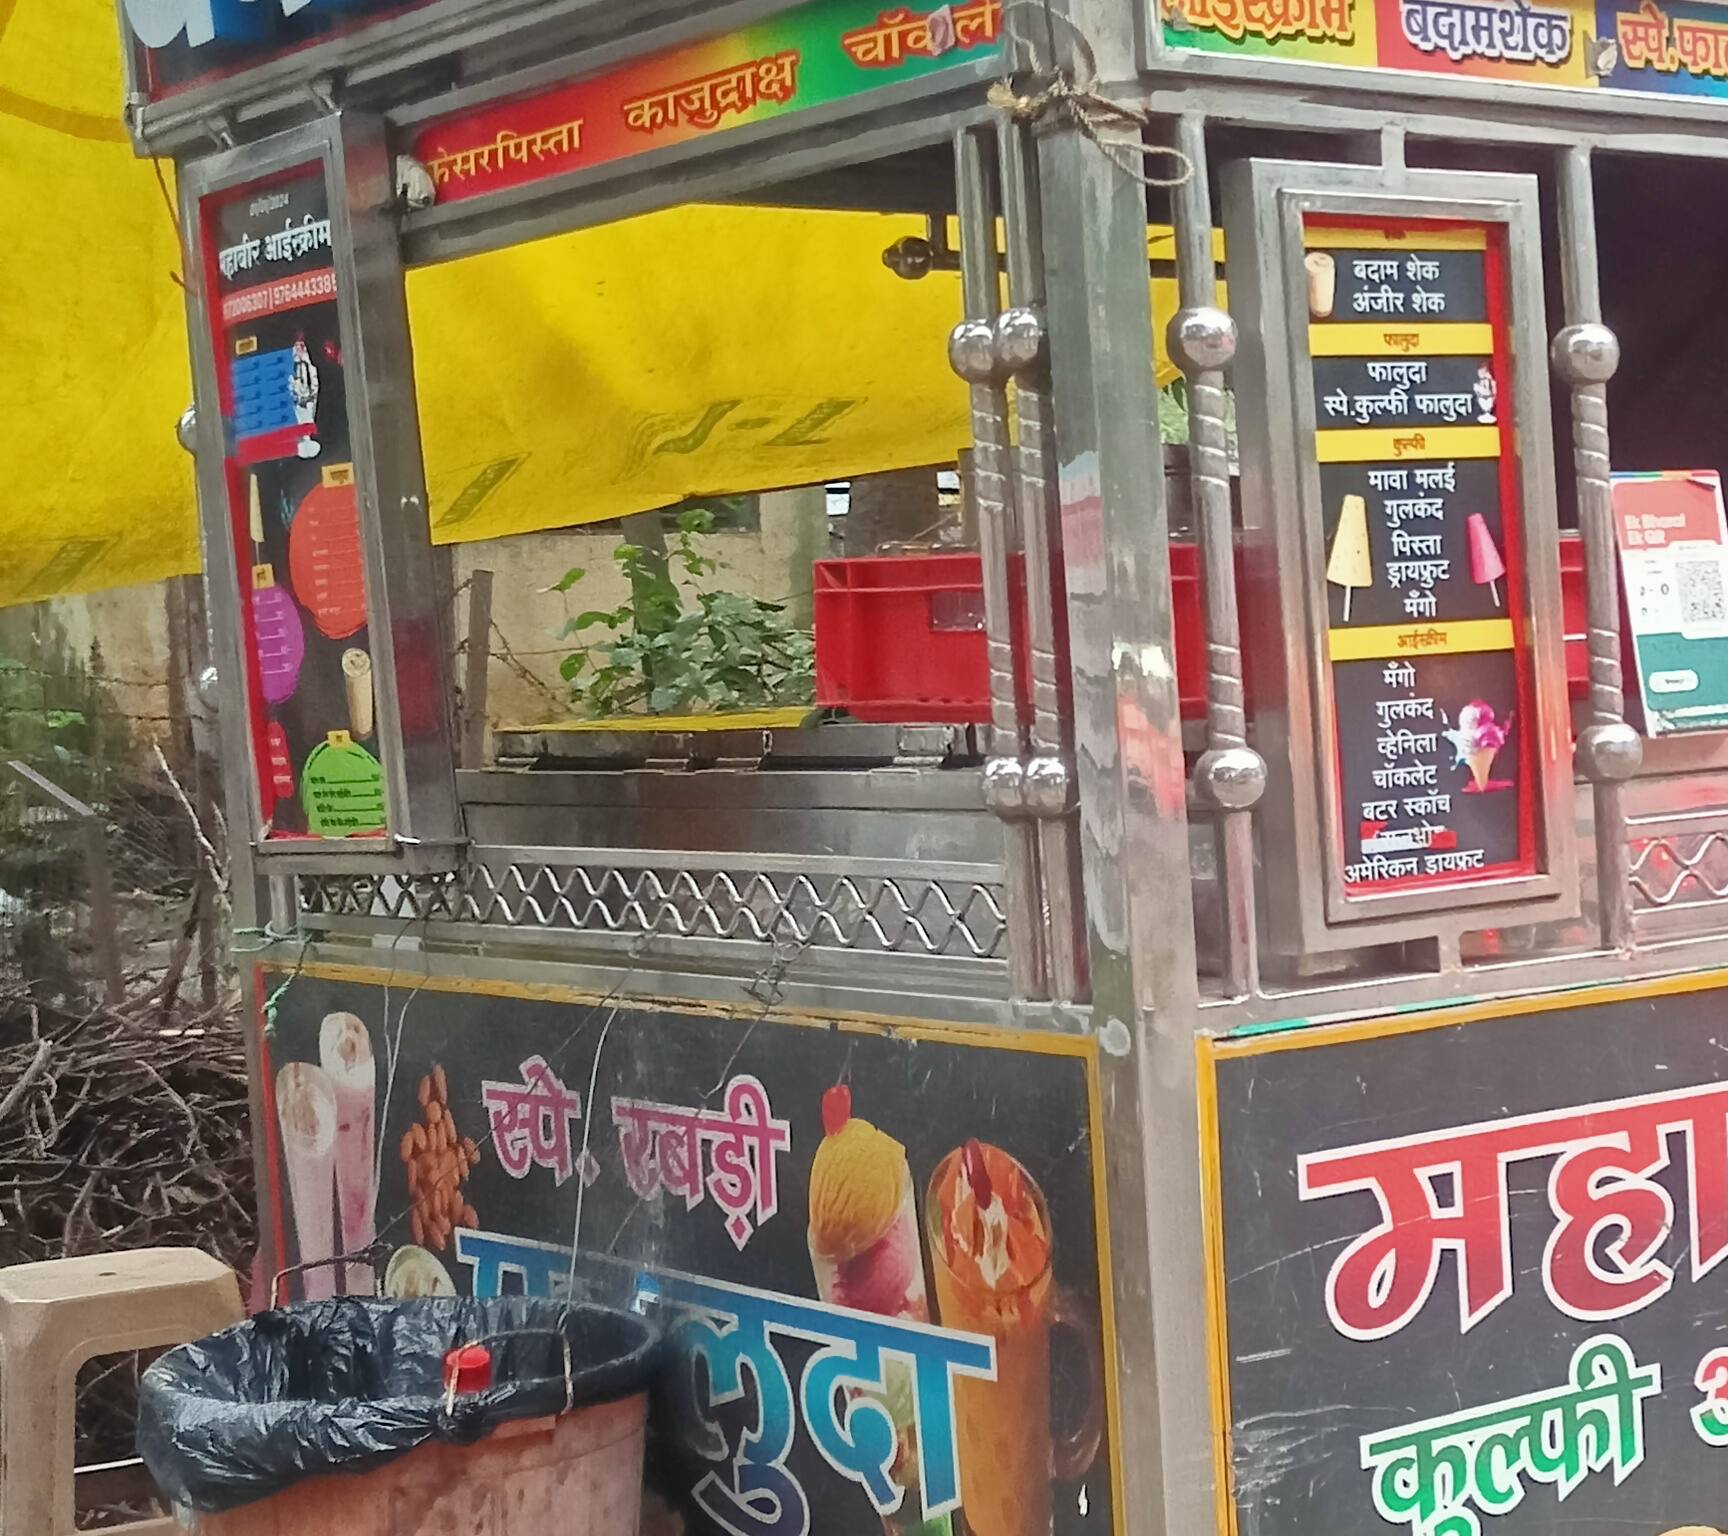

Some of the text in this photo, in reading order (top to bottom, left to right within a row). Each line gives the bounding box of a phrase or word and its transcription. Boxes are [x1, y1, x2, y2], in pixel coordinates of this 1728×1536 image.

[1352, 253, 1440, 283] बदाम शेक
[1352, 284, 1446, 313] अंजीर शेक
[1366, 361, 1428, 390] फालुदा
[1414, 393, 1473, 425] फालुदा
[1368, 461, 1456, 493] मावा मलई
[1384, 492, 1444, 528] गुलकंद
[1391, 533, 1442, 558] पिस्ता
[1376, 692, 1434, 729] गुलकंद
[1376, 728, 1438, 760] व्हेनिला
[1372, 760, 1438, 790] चॉकलेट
[1361, 789, 1451, 822] बटर स्कॉच
[1343, 855, 1419, 884] अमेरिकन
